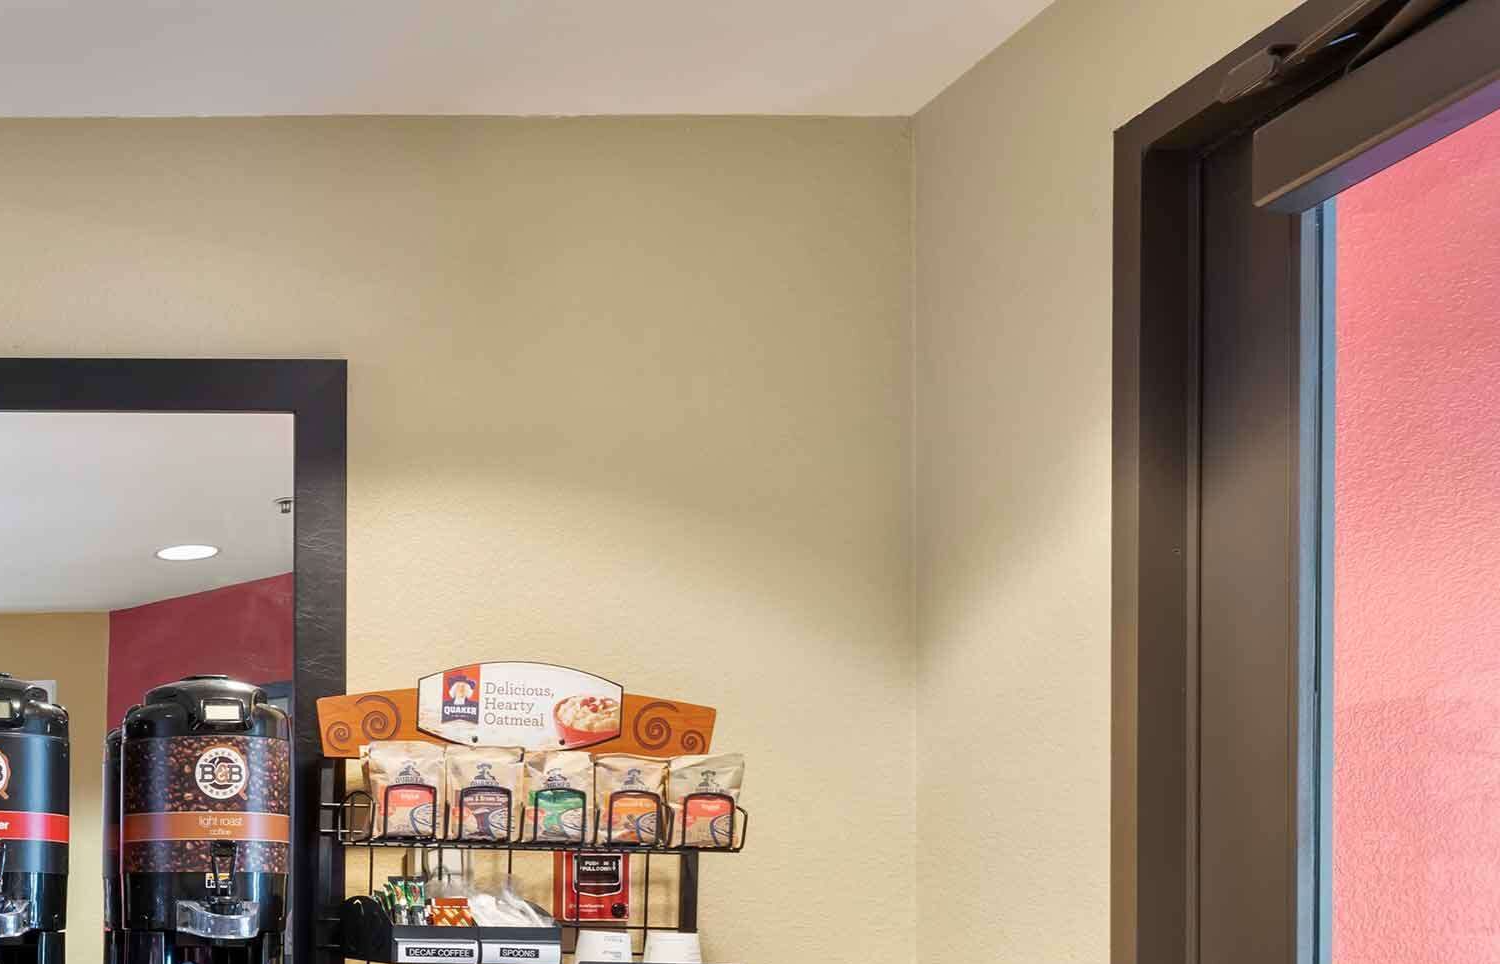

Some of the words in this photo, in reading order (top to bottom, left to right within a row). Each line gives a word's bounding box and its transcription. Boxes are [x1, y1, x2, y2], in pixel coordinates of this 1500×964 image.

[485, 682, 555, 698] Delicious,
[444, 706, 477, 715] QUAKER
[485, 698, 534, 713] Hearty
[484, 712, 545, 727] Oatmeal
[199, 763, 243, 784] B&B
[199, 815, 217, 828] light
[219, 816, 243, 825] roast
[409, 948, 436, 956] DECAF
[437, 949, 470, 957] COFFEE
[502, 949, 536, 957] SPOONS
